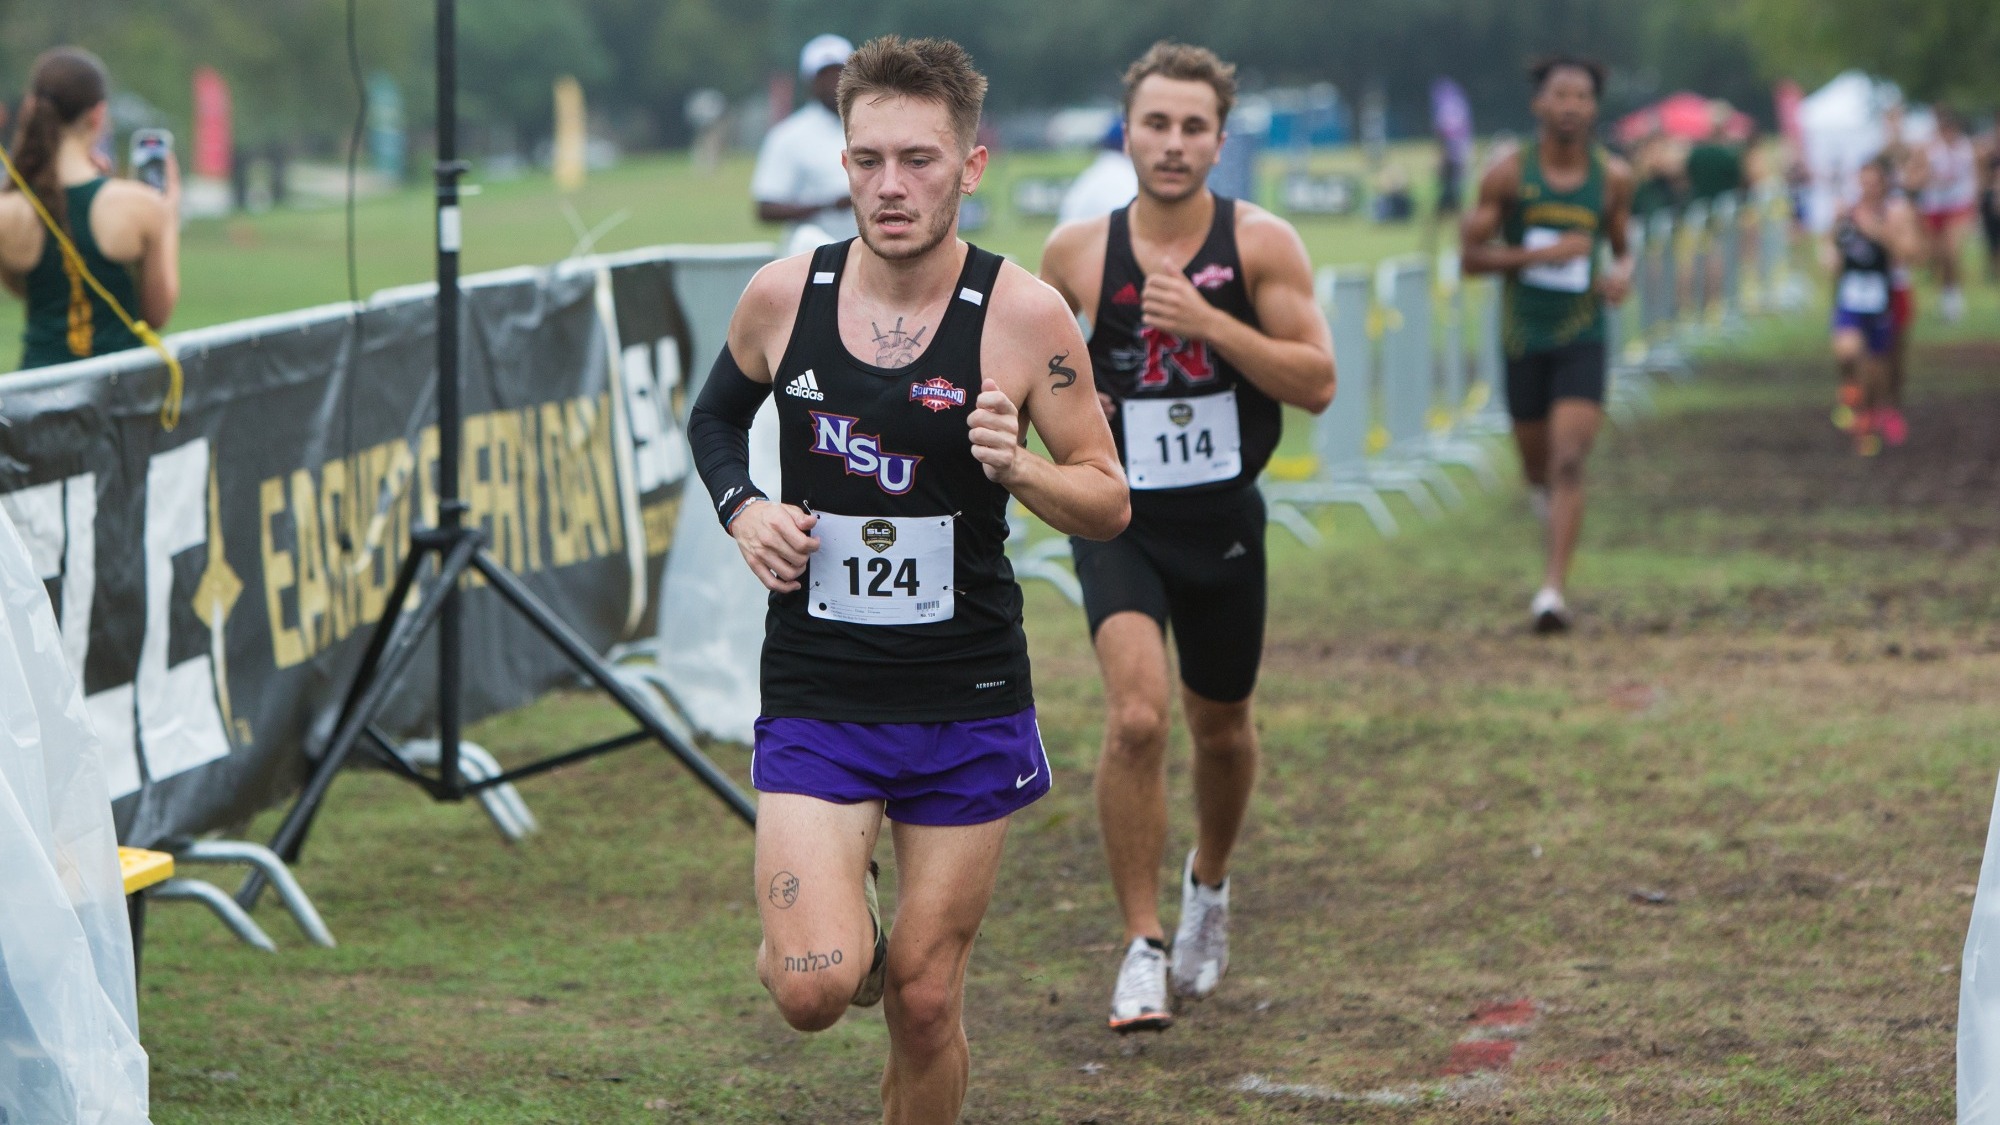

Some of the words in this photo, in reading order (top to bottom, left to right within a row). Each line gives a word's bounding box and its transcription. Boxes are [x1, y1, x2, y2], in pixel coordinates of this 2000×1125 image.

[785, 384, 824, 401] adidas
[911, 384, 964, 404] SOUTHLAND
[814, 414, 917, 492] NSU
[1156, 430, 1215, 464] 114
[842, 556, 920, 597] 124
[0, 437, 231, 801] LC
[784, 949, 843, 973] סבלנות
